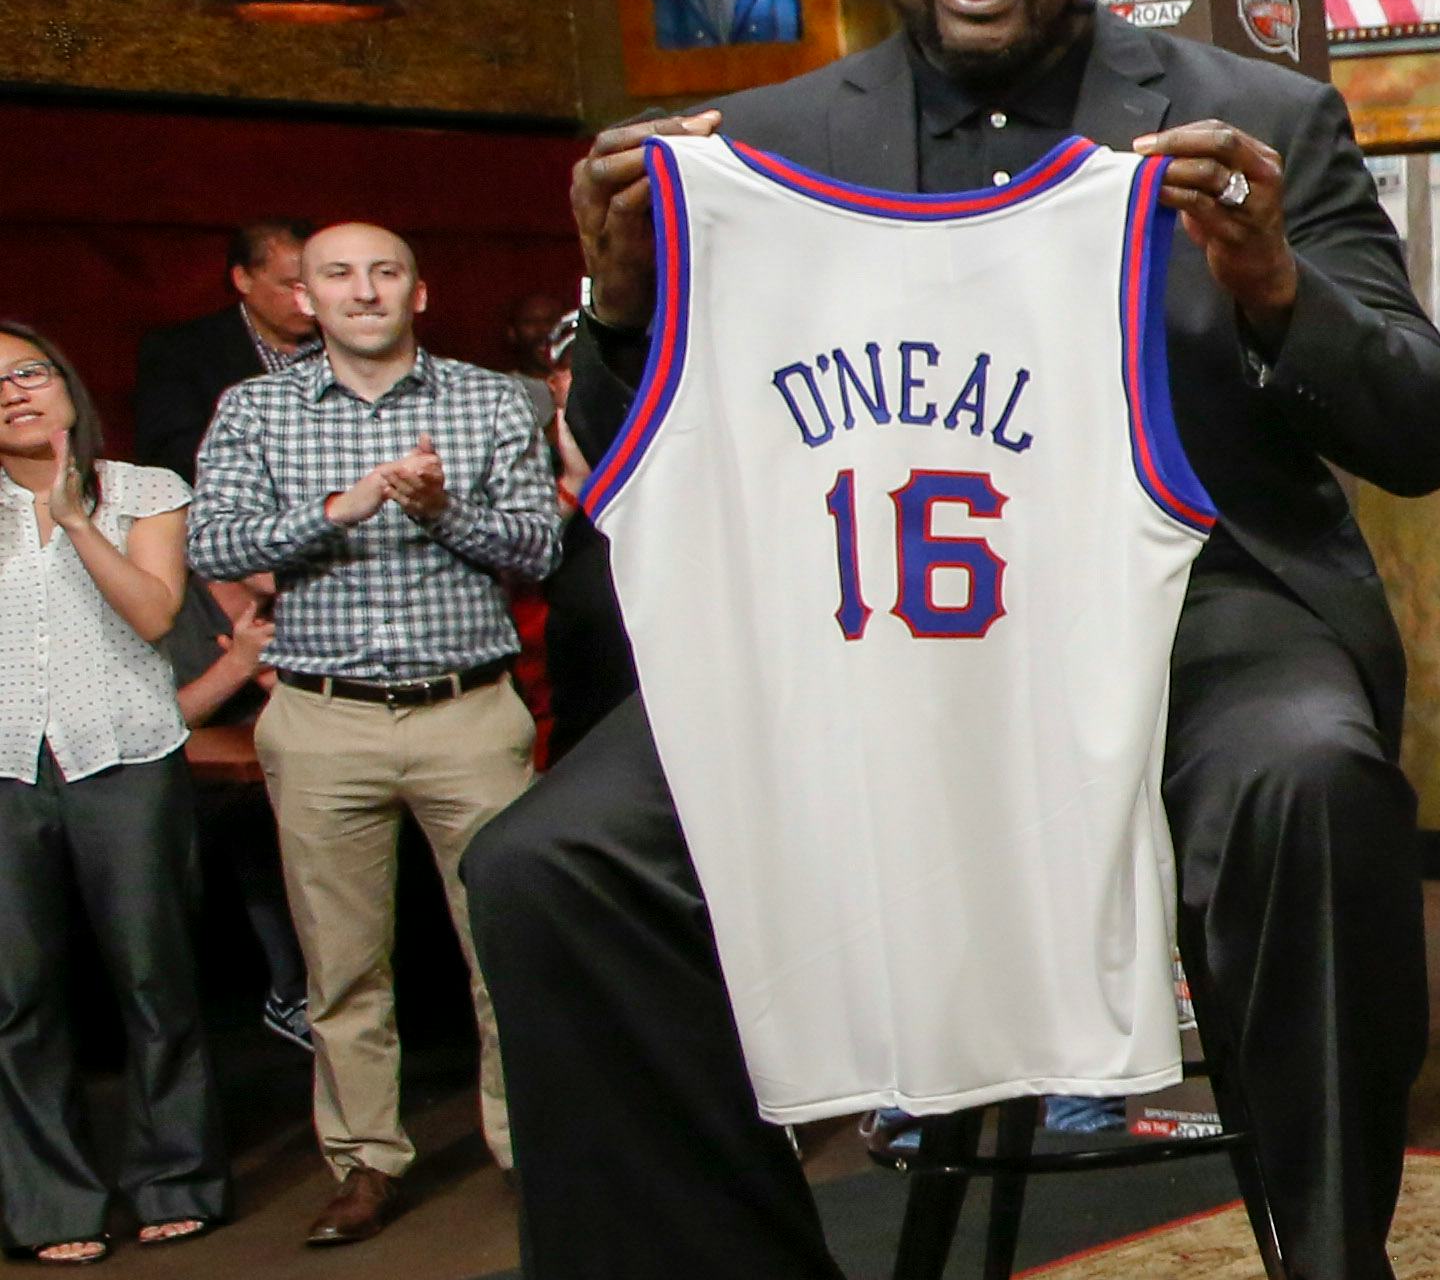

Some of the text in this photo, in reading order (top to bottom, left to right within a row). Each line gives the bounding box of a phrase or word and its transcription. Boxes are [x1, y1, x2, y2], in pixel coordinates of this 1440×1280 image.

[1132, 4, 1183, 23] ROAD
[771, 341, 1034, 454] O'NEAL
[825, 468, 1011, 642] 16
